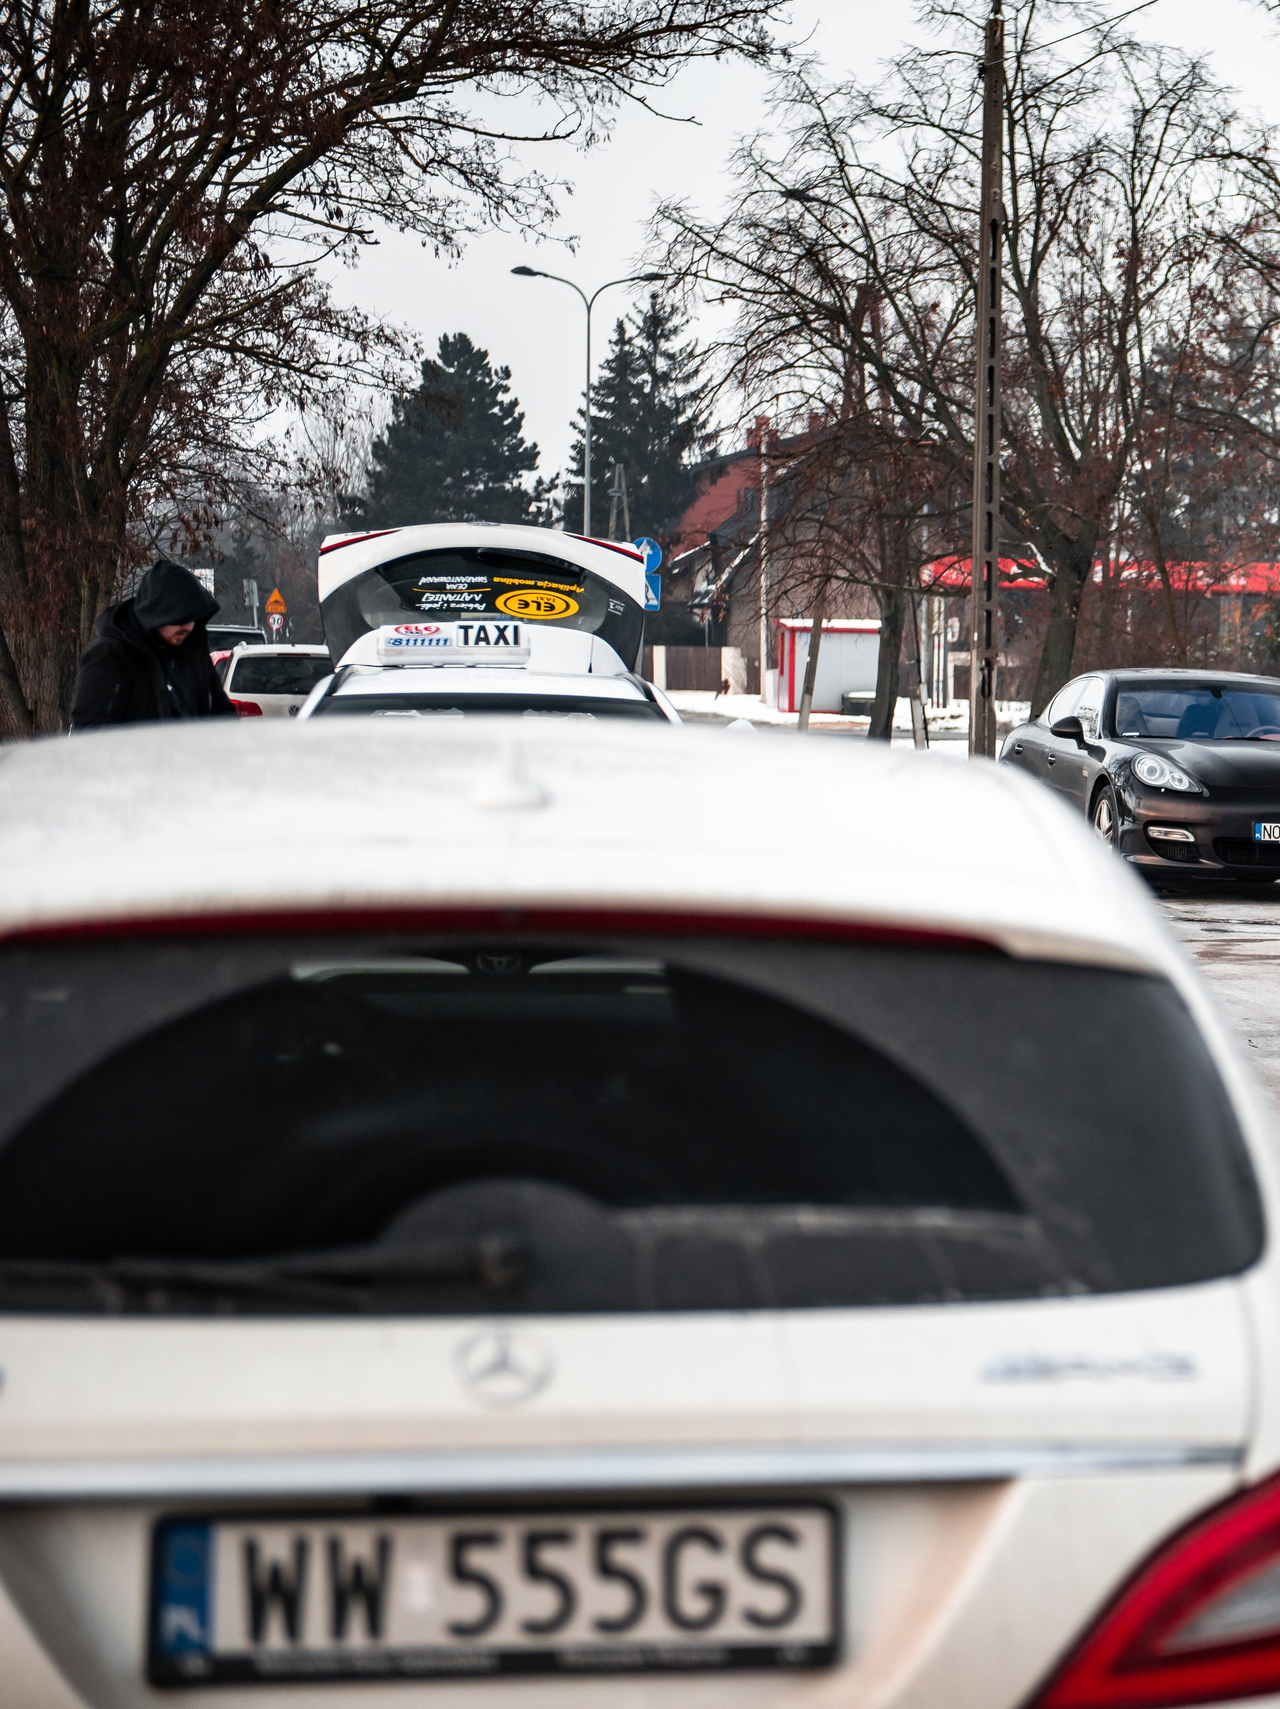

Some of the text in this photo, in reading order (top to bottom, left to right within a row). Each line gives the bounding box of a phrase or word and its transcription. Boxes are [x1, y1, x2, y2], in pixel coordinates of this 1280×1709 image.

[493, 576, 585, 593] Aplikacja mobilna
[517, 598, 556, 613] ELE
[535, 595, 556, 603] TAXI
[269, 615, 282, 626] 30
[458, 625, 520, 646] TAXI
[243, 1522, 804, 1645] WW 555GS
